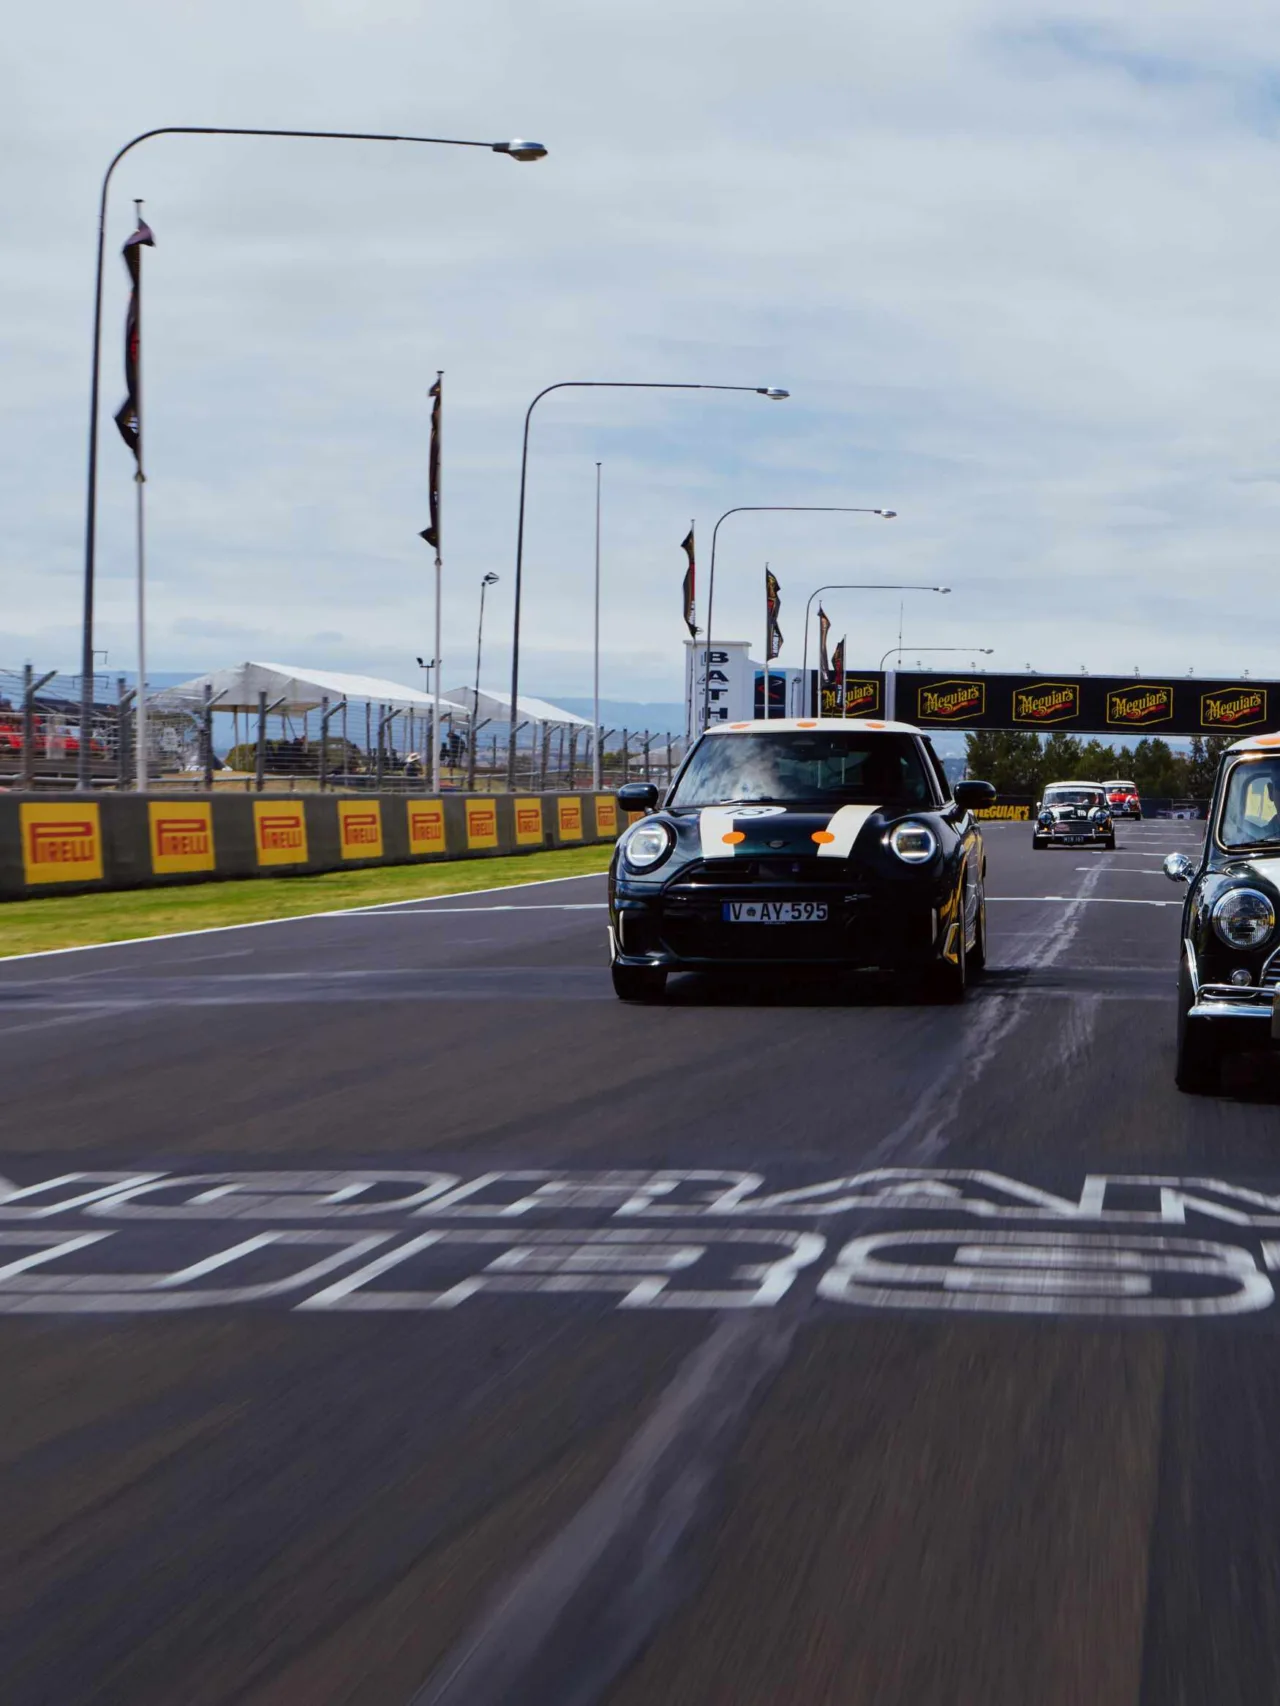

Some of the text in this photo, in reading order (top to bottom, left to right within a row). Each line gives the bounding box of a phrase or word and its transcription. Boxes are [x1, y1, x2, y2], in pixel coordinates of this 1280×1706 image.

[924, 685, 979, 713] Meguiar's
[1018, 687, 1074, 716] Meguiar's
[1112, 689, 1168, 718] Meguiar's
[1206, 691, 1262, 721] Meguiar's
[156, 819, 208, 856] PIRELLI
[260, 816, 301, 849] PIRELLI
[344, 814, 377, 845] PIRELLI
[412, 813, 441, 841] PIRELLI
[31, 822, 94, 863] PIRELLI
